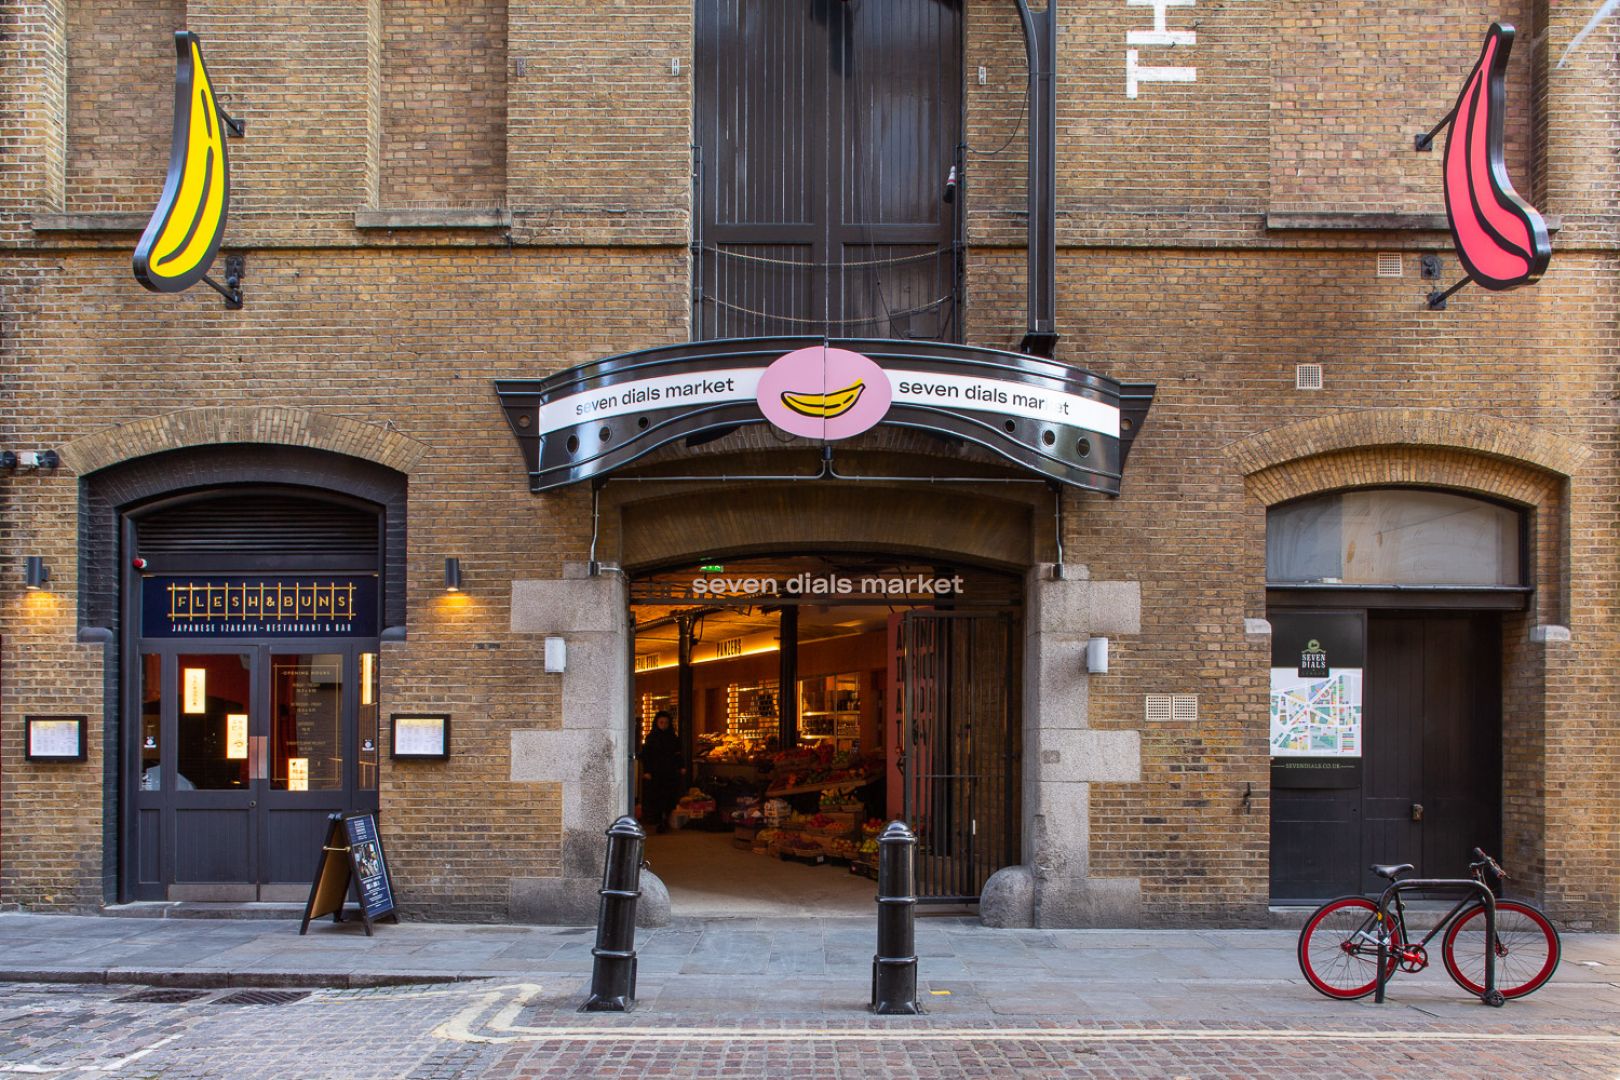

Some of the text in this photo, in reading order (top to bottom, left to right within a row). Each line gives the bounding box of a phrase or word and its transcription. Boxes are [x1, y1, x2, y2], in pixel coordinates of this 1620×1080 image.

[576, 377, 735, 416] seven dials market
[899, 380, 1070, 416] seven dials mart
[692, 572, 964, 595] seven dials market
[172, 623, 215, 632] JAPANESE
